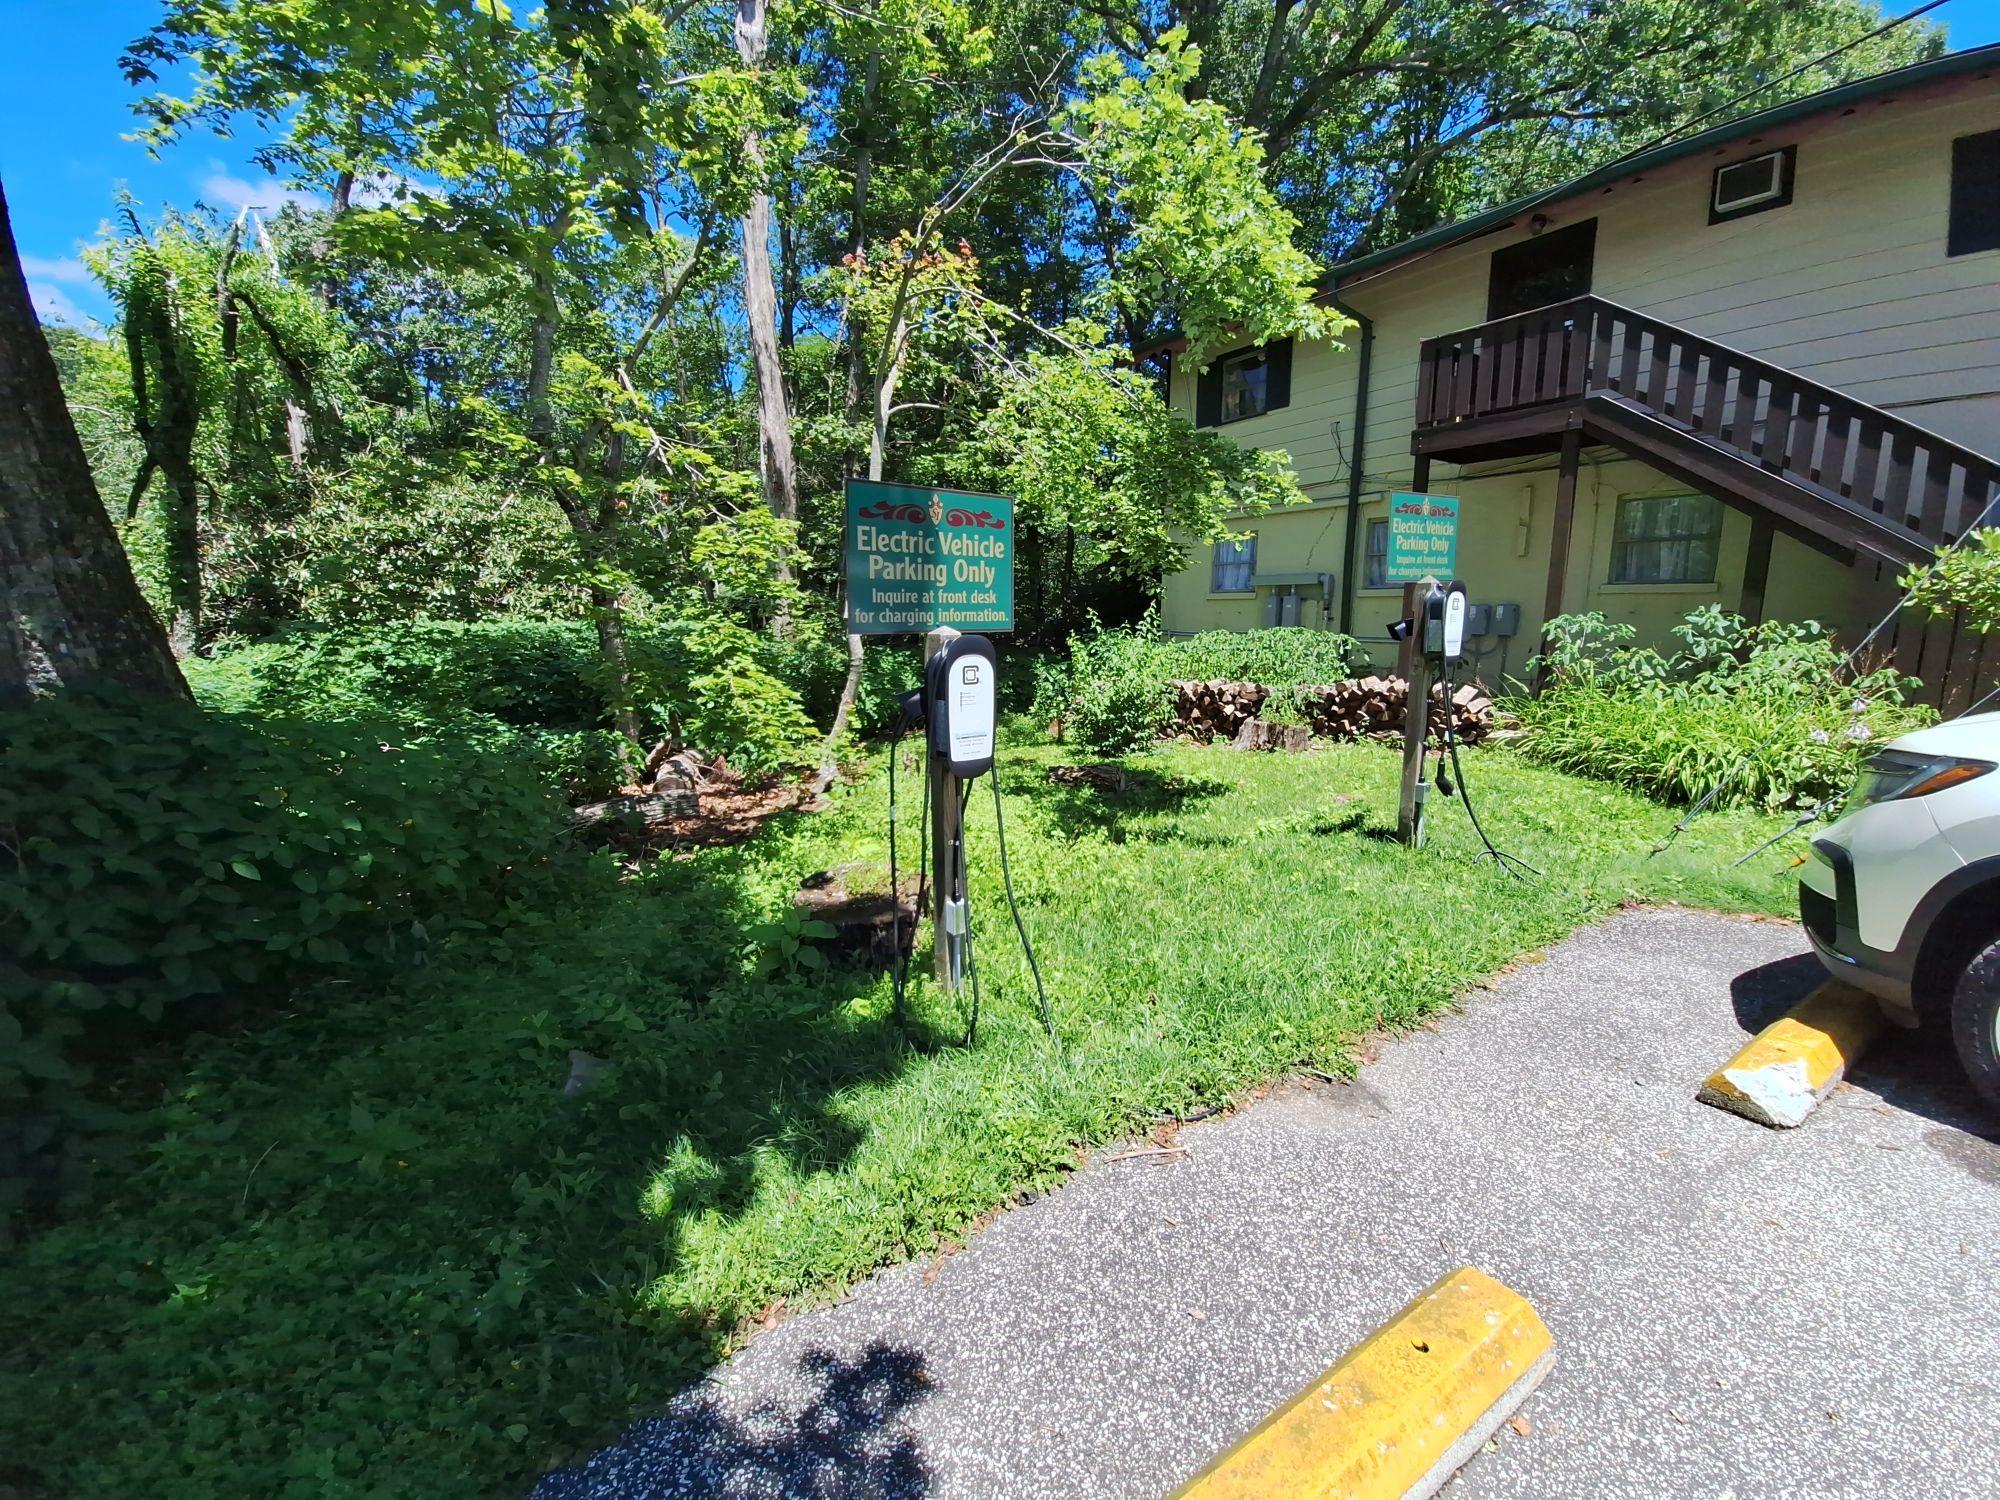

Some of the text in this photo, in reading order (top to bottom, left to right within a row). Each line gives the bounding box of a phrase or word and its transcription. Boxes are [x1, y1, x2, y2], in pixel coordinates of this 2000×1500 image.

[1393, 518, 1454, 535] Electric Vehicle
[857, 525, 1005, 559] Electric Vehicle
[1396, 535, 1449, 554] Parking Only
[869, 555, 995, 588] Parking Only
[872, 588, 996, 606] Inquire at front desk
[855, 608, 1009, 626] for charging information.
